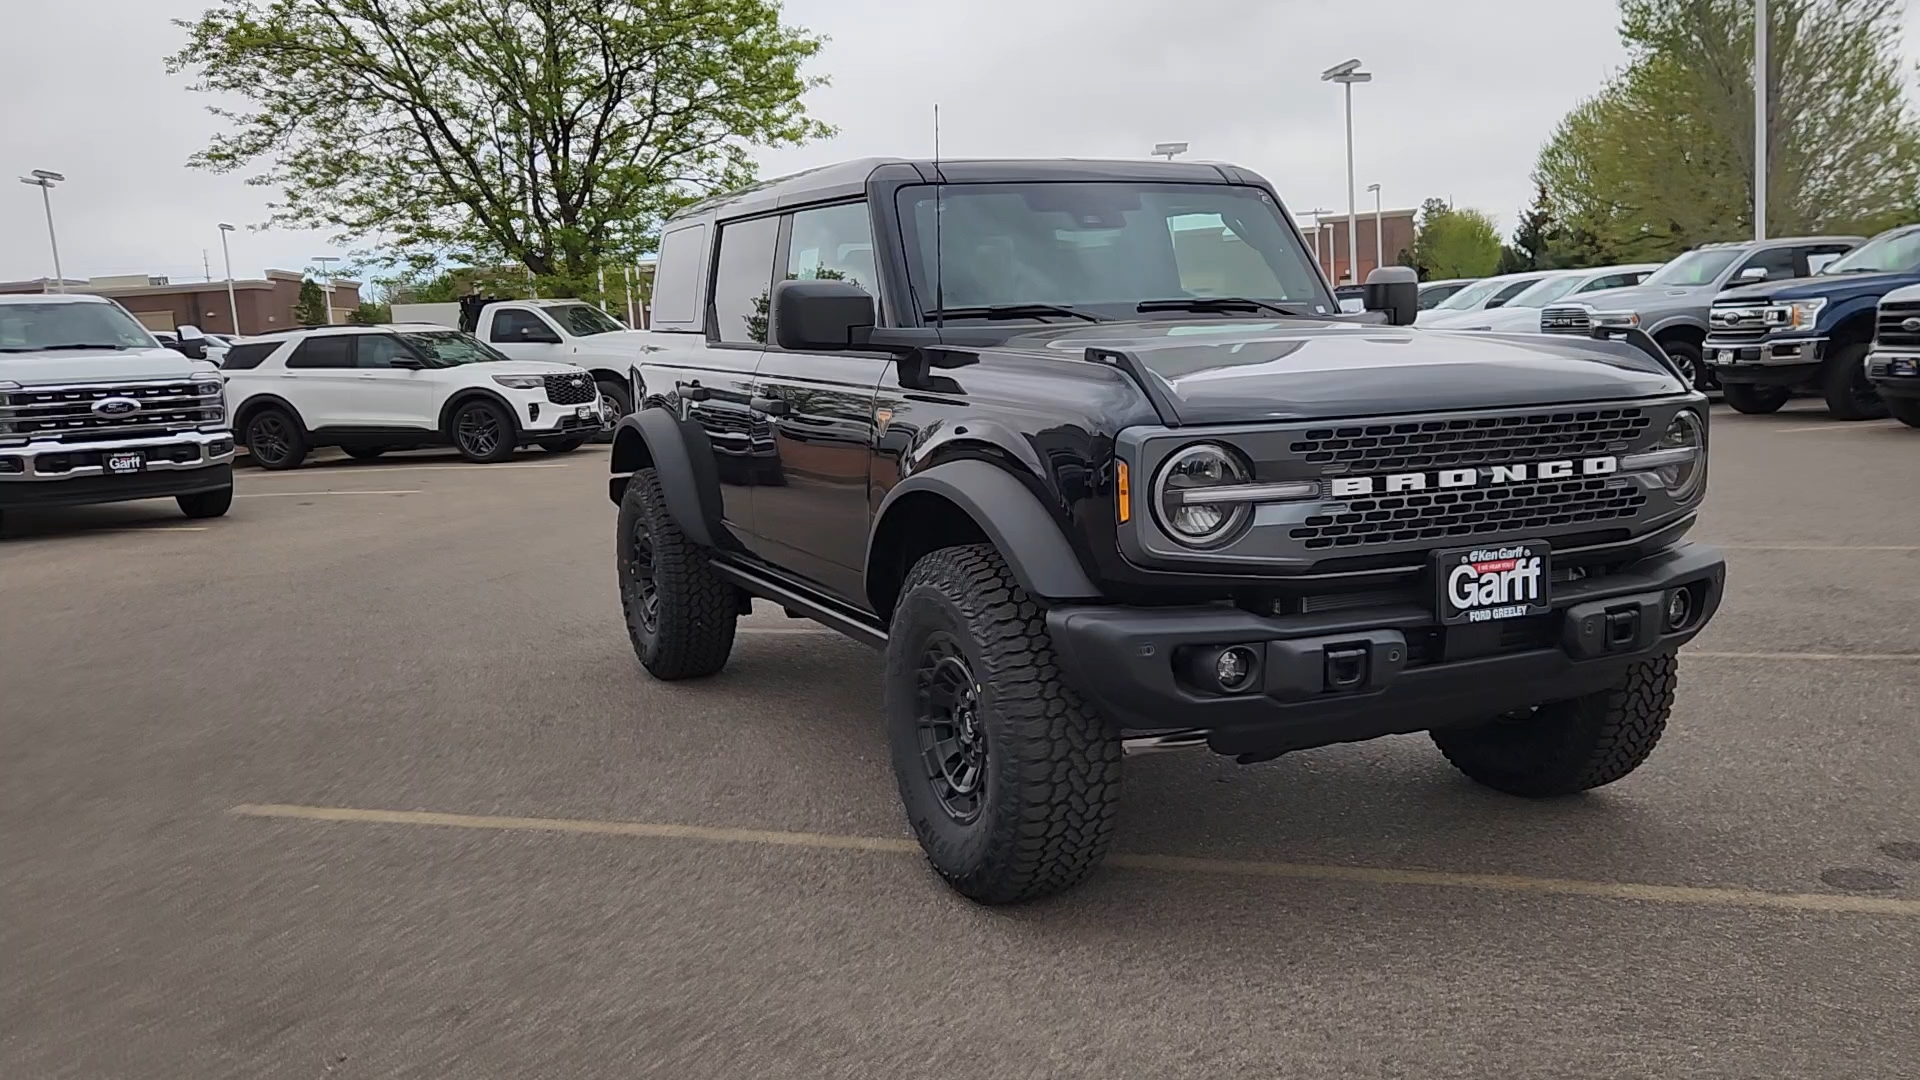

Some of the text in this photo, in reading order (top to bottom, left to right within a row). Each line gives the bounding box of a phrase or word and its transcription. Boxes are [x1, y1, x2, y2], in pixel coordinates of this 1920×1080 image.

[106, 403, 128, 412] Ford
[109, 456, 140, 470] Garff
[1331, 456, 1617, 497] BRONCO
[1498, 546, 1524, 559] Garff
[1448, 557, 1541, 609] Garff
[1469, 605, 1528, 622] FORD GREELEY
